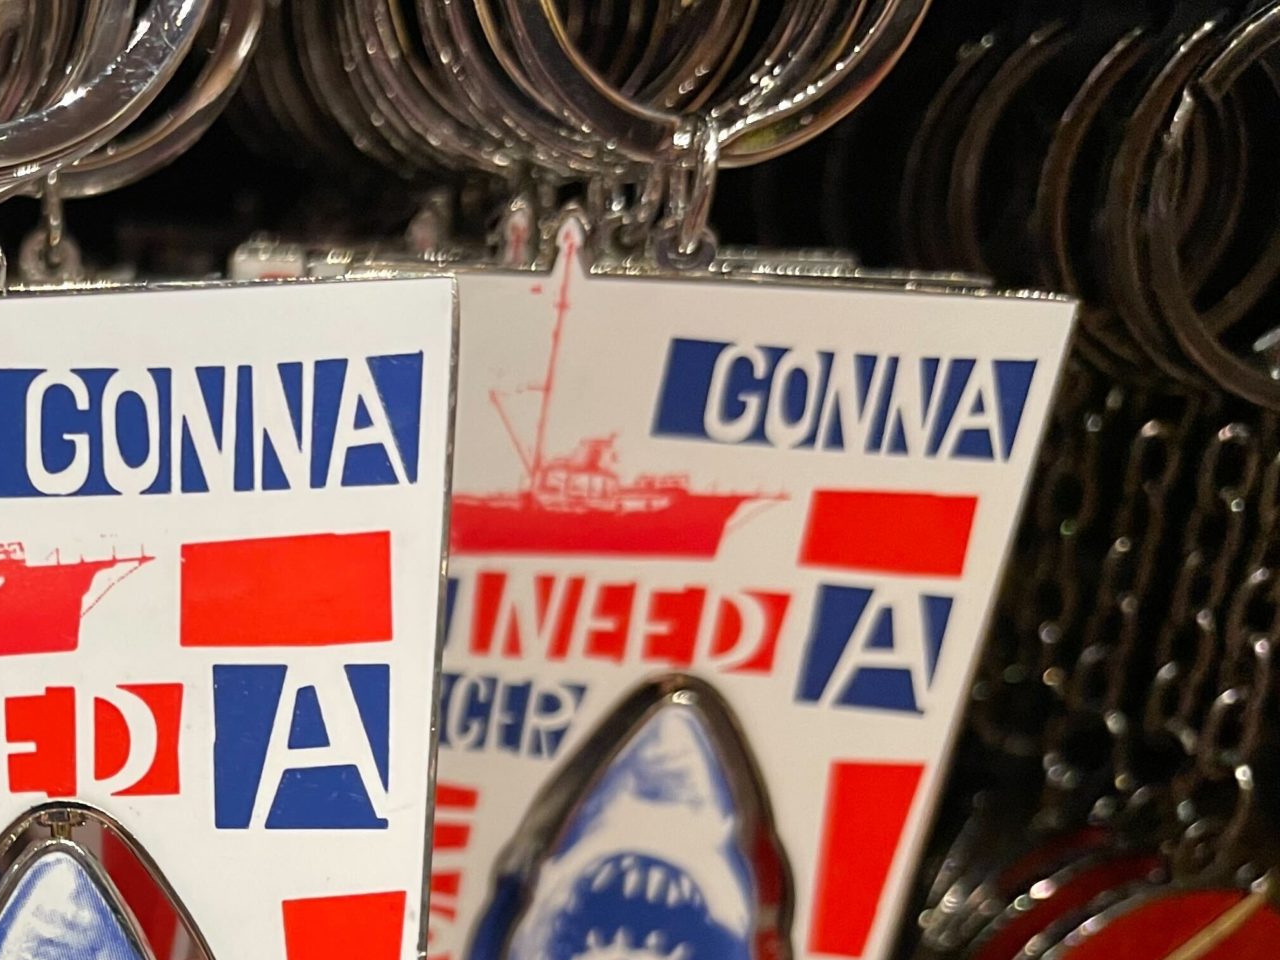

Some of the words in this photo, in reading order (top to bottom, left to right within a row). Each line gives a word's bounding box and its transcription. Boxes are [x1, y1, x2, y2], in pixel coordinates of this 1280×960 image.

[20, 350, 424, 498] GONNA
[696, 340, 1032, 461] GONNA
[482, 572, 786, 674] NEED
[800, 584, 950, 714] A
[240, 664, 390, 830] A
